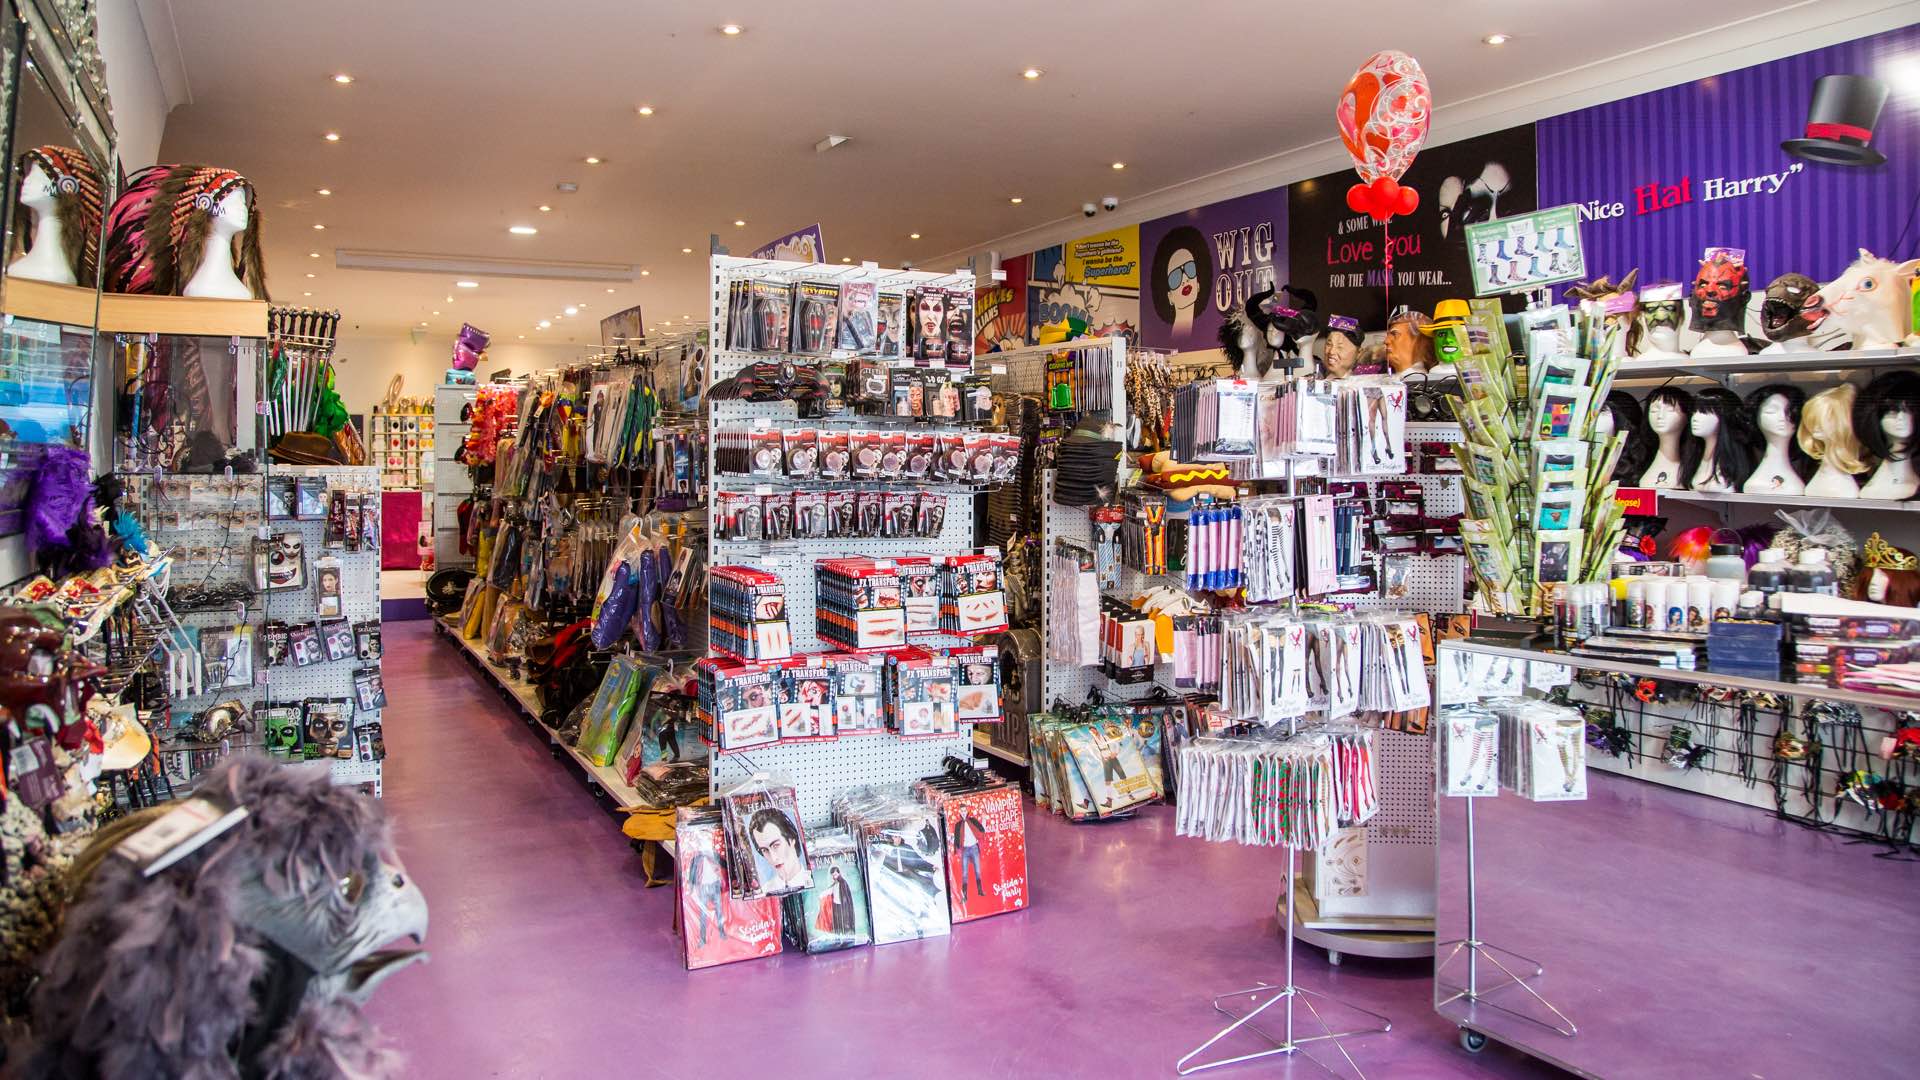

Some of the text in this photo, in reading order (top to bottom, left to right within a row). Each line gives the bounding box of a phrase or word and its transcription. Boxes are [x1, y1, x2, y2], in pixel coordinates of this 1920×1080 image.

[1577, 199, 1625, 223] Nice
[1633, 176, 1694, 216] Hat
[1345, 215, 1369, 233] SOME
[1213, 222, 1274, 270] WIG
[1327, 236, 1374, 265] Love
[1329, 269, 1452, 288] FOR THE MASK YOU WEAR...
[1215, 265, 1274, 312] OUT
[904, 566, 936, 576] TRANSFERS
[966, 562, 997, 573] TRANSFERS
[868, 577, 900, 587] TRANSFERS
[959, 656, 992, 664] TRANSFERS
[781, 668, 829, 678] FX TRANSFERS
[837, 663, 873, 672] TRANSFERS
[915, 668, 951, 678] TRANSFERS
[724, 673, 771, 688] FX TRANSFERS
[984, 797, 1019, 815] VAMPIRE
[999, 809, 1019, 823] CAPE
